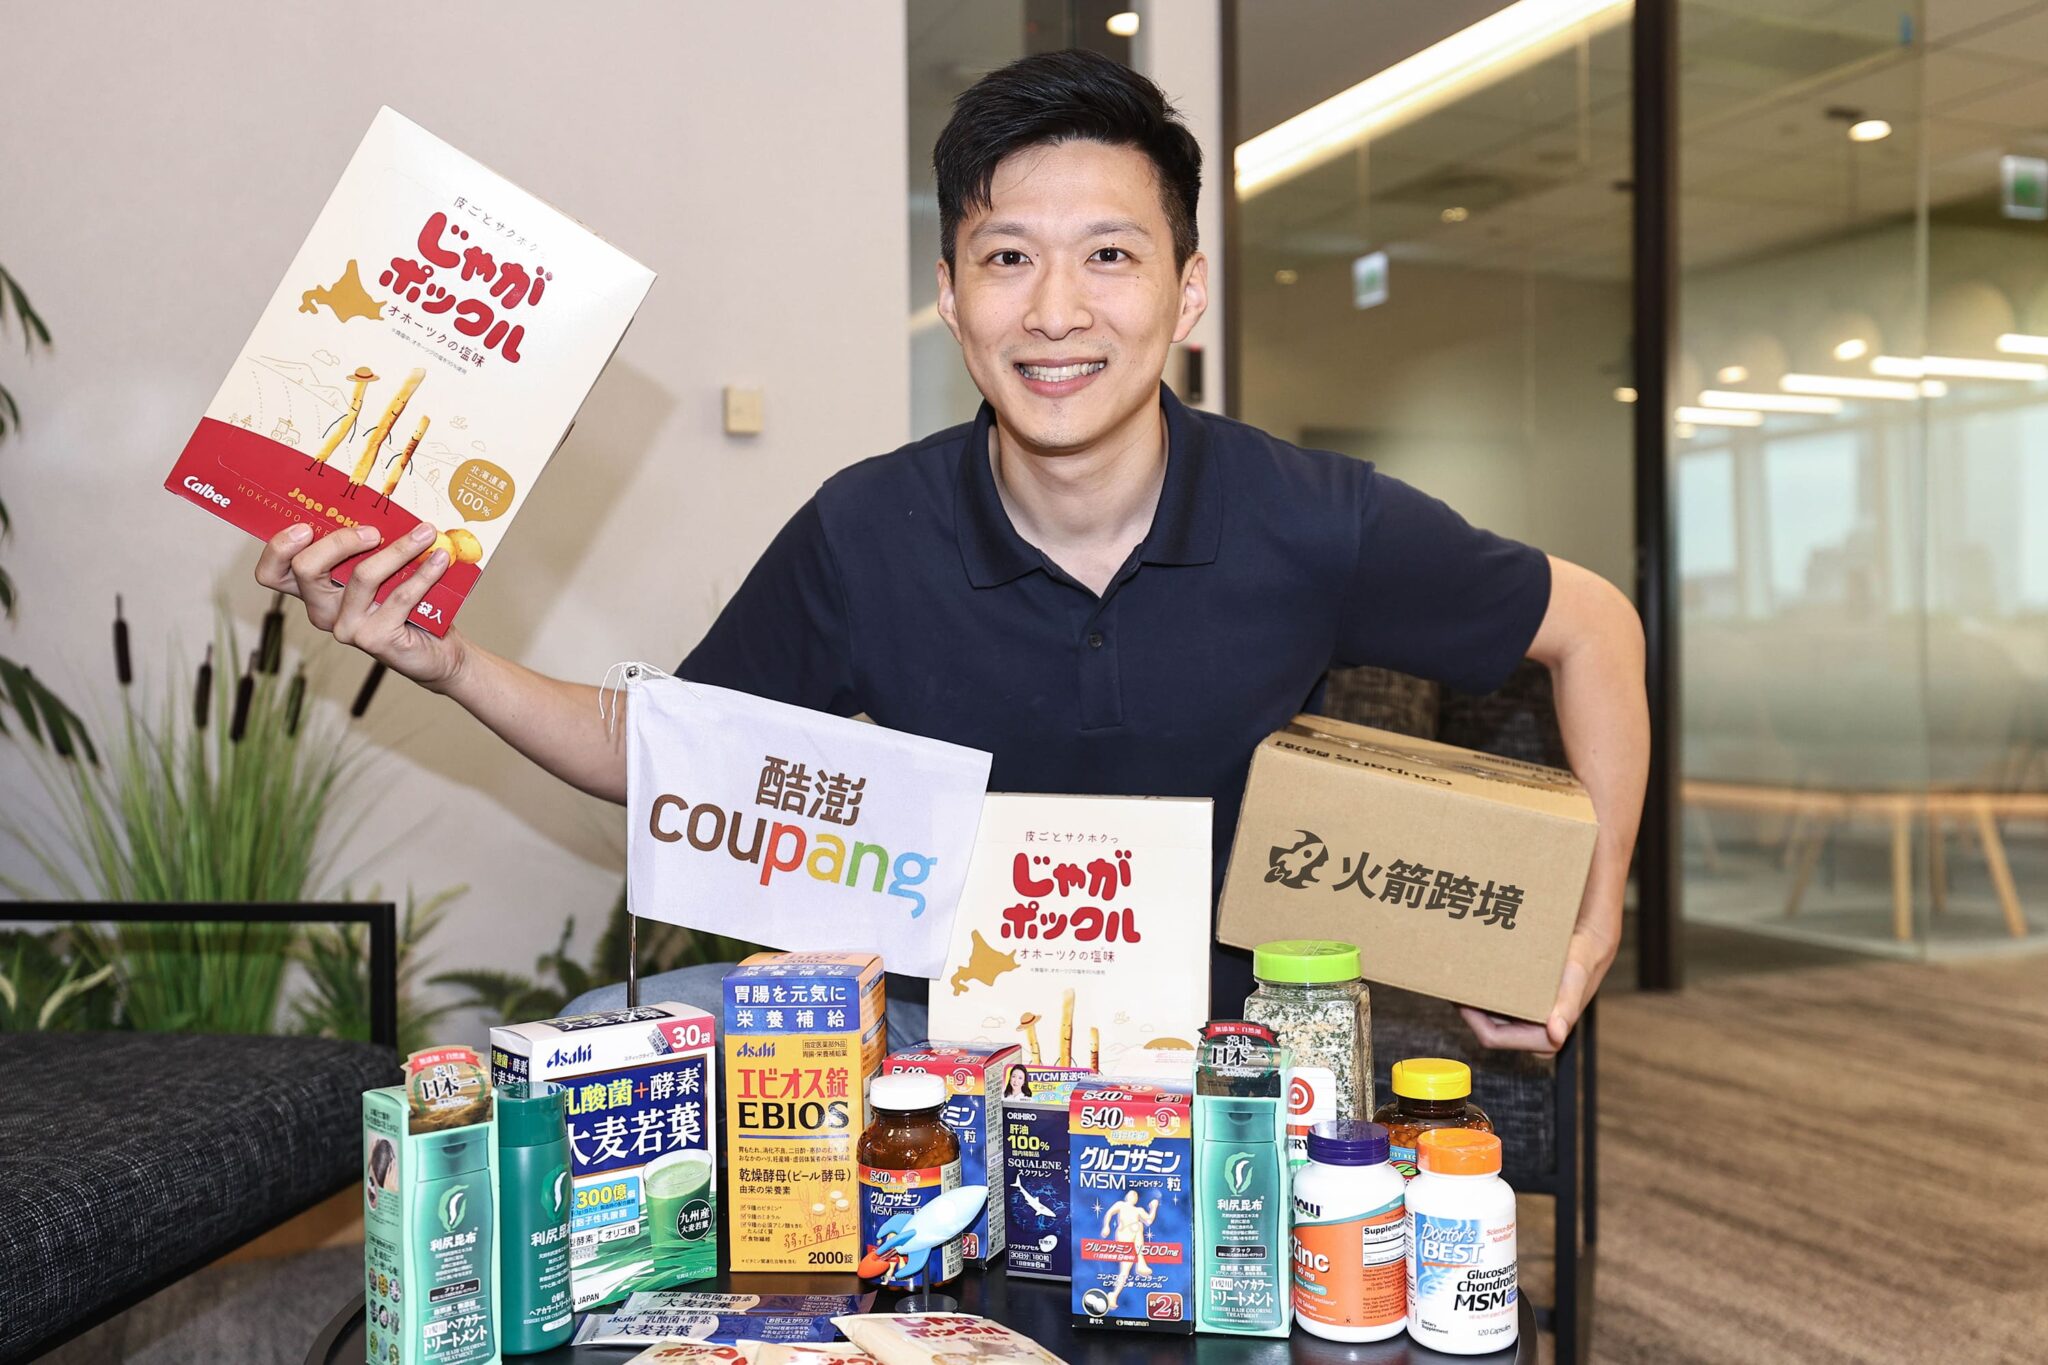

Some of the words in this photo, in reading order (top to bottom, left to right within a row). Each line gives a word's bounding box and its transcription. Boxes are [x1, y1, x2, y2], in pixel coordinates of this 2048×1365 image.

[453, 196, 545, 259] 皮ごとサクホク
[418, 212, 553, 309] じゃが
[379, 257, 524, 363] ポックル
[388, 305, 486, 368] オホーツクの塩味
[470, 465, 507, 490] 北海道産
[182, 475, 231, 508] Calbee
[288, 487, 323, 512] Jaga
[237, 483, 302, 523] HOKKAIDO
[456, 488, 492, 517] 100%
[756, 755, 866, 826] 酷澎
[649, 793, 938, 919] coupang
[1013, 850, 1132, 901] じゃが
[1331, 852, 1526, 930] 火箭跨境
[1001, 901, 1141, 943] ポックル
[1019, 949, 1115, 963] オホーツクの塩味
[735, 985, 846, 1003] 胃腸を元気に
[672, 1025, 711, 1049] 30袋
[546, 1043, 592, 1069] Asahi
[736, 1041, 776, 1058] Asahi
[1212, 1046, 1268, 1066] 日本一
[421, 1076, 480, 1102] 日本一
[737, 1067, 849, 1099] エビオス錠
[738, 1101, 850, 1130] EBIOS
[940, 1106, 975, 1127] ミン
[1007, 1112, 1037, 1121] ORIHIRO
[964, 1130, 976, 1143] 粒
[1009, 1123, 1029, 1135] 肝油
[1007, 1135, 1050, 1151] 100%
[1008, 1158, 1062, 1170] SQUALENE
[1080, 1146, 1181, 1173] グルコサミン
[1018, 1169, 1052, 1178] スクワレン
[1080, 1173, 1126, 1190] MSM
[1129, 1180, 1164, 1188] コンドロイチン
[1167, 1177, 1181, 1192] 粒
[739, 1185, 791, 1195] 由来の栄養素
[870, 1191, 921, 1207] グルコサミン
[870, 1206, 892, 1216] MSM
[1217, 1199, 1263, 1211] 利尻昆布
[680, 1208, 710, 1225] 九州産
[530, 1223, 571, 1247] 利尻昆
[605, 1225, 637, 1239] オリゴ糖
[681, 1222, 709, 1236] 大麦若葉
[1422, 1224, 1476, 1243] Doctor's
[1009, 1243, 1040, 1252] ソフトカプセル
[1010, 1252, 1030, 1260] 30日分
[1085, 1242, 1133, 1253] グルコサミン
[1423, 1240, 1484, 1263] BEST
[808, 1251, 854, 1265] 2000錠
[1305, 1271, 1316, 1281] mg
[1467, 1261, 1517, 1280] Glucosamin
[1234, 1279, 1273, 1290] ヘアカラー
[1457, 1273, 1517, 1292] Chondroiti
[578, 1293, 600, 1306] JAPAN
[661, 1298, 733, 1310] 大麦若葉
[689, 1294, 753, 1302] 乳酸菌+酵素
[1210, 1290, 1274, 1307] トリートメント
[1454, 1290, 1506, 1311] MSM
[448, 1313, 488, 1329] ヘアカラー
[645, 1316, 713, 1324] 乳酸菌+酵素
[615, 1325, 693, 1337] 大麦若葉
[1490, 1325, 1511, 1336] Capsules
[423, 1326, 488, 1355] トリートメント
